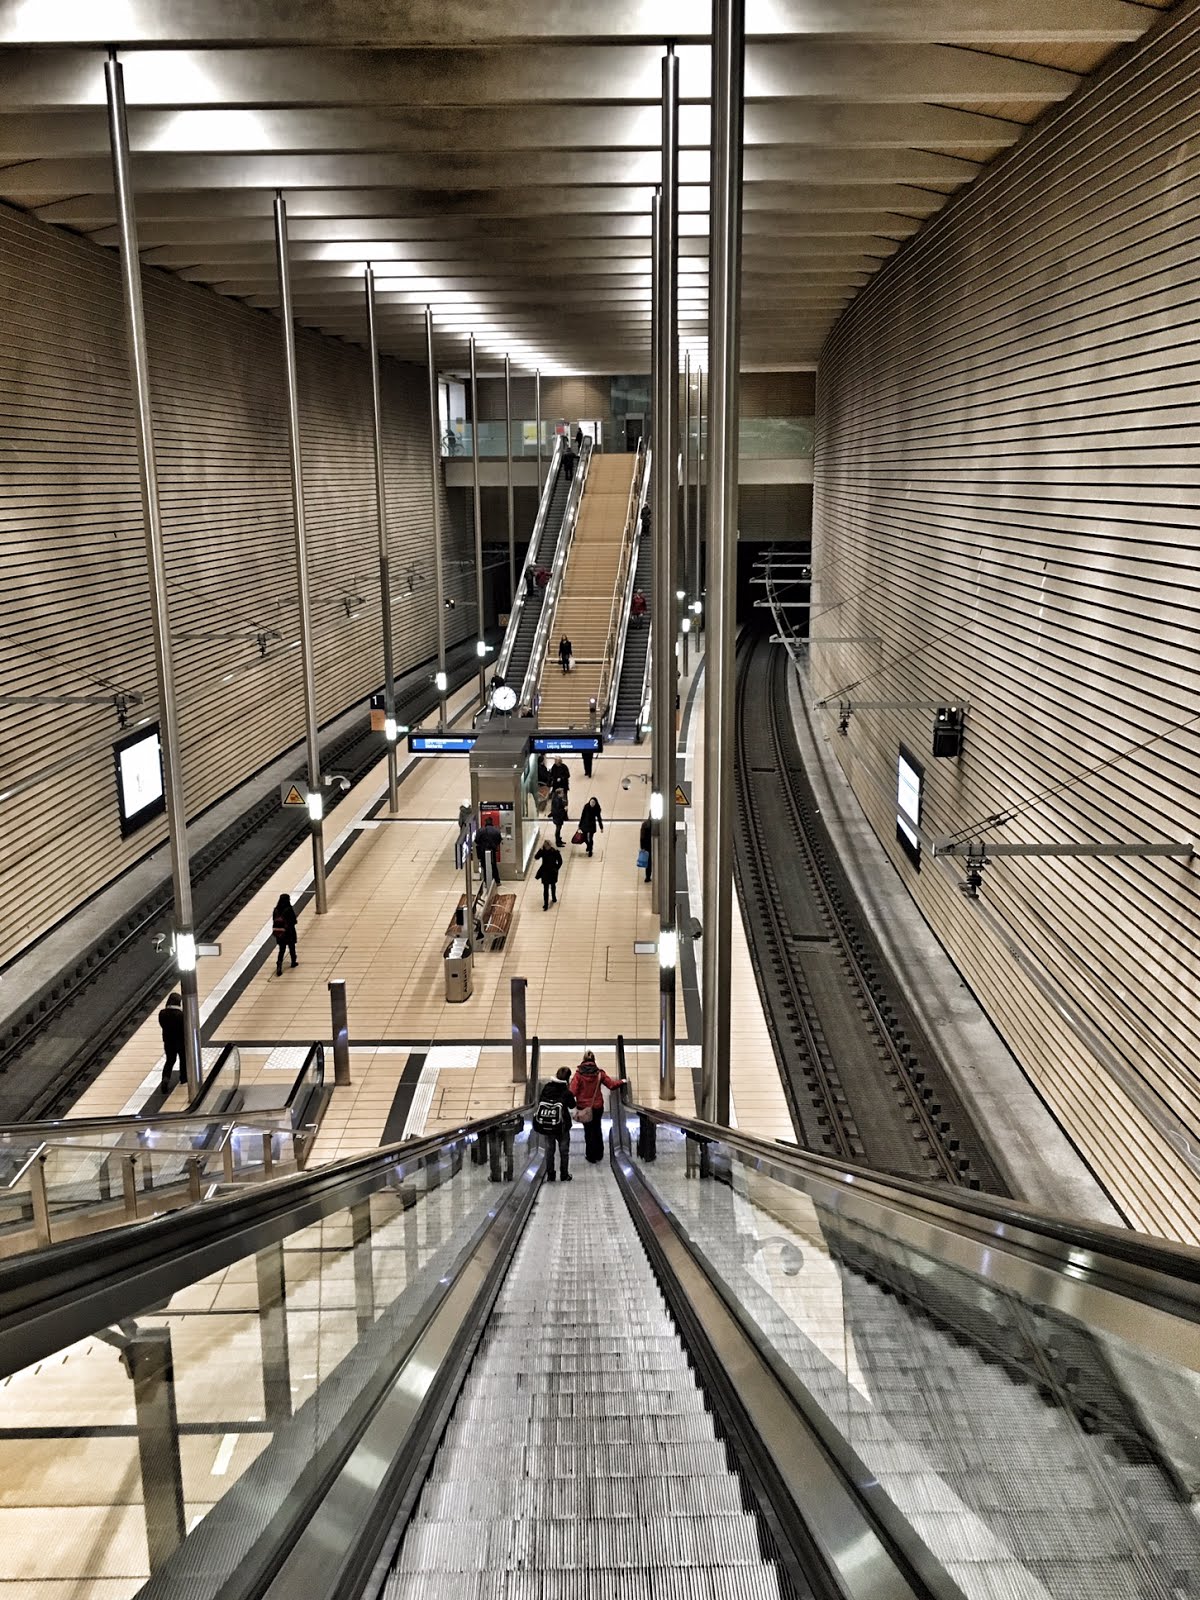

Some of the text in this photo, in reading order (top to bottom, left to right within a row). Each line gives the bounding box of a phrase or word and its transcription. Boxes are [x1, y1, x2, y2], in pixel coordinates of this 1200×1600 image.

[372, 695, 378, 706] 1
[412, 739, 417, 747] 1
[593, 739, 599, 747] 2
